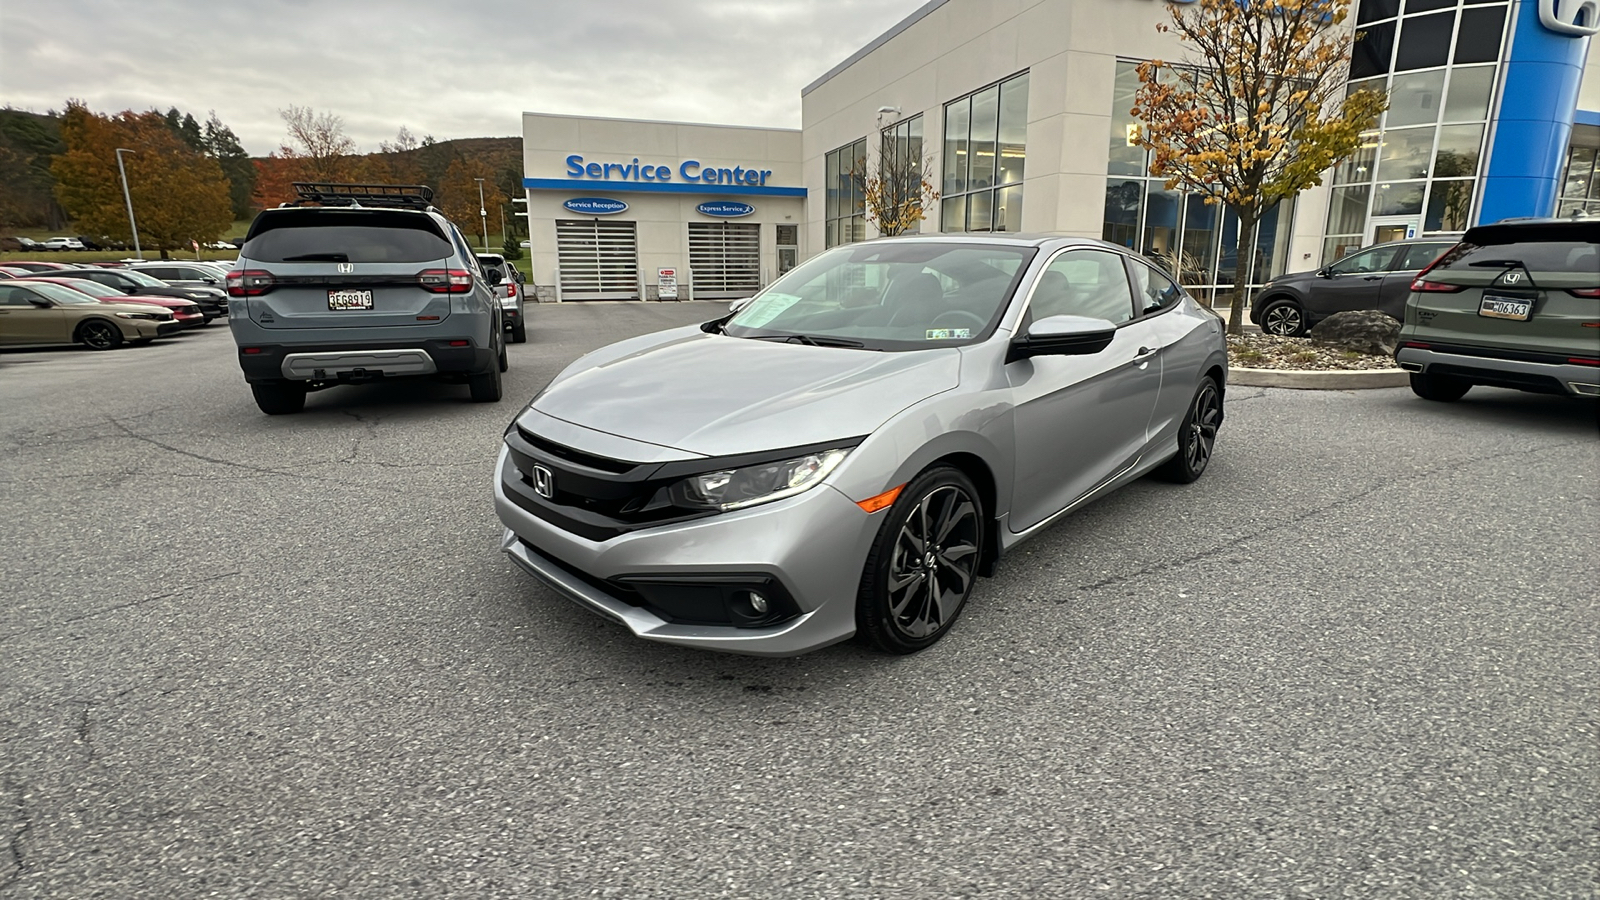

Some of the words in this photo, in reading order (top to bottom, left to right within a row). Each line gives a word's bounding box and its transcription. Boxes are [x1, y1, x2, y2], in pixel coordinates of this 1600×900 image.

[566, 155, 671, 181] Service
[679, 160, 772, 185] Center
[567, 201, 592, 209] Service
[592, 202, 625, 211] Reception
[700, 205, 722, 213] Express
